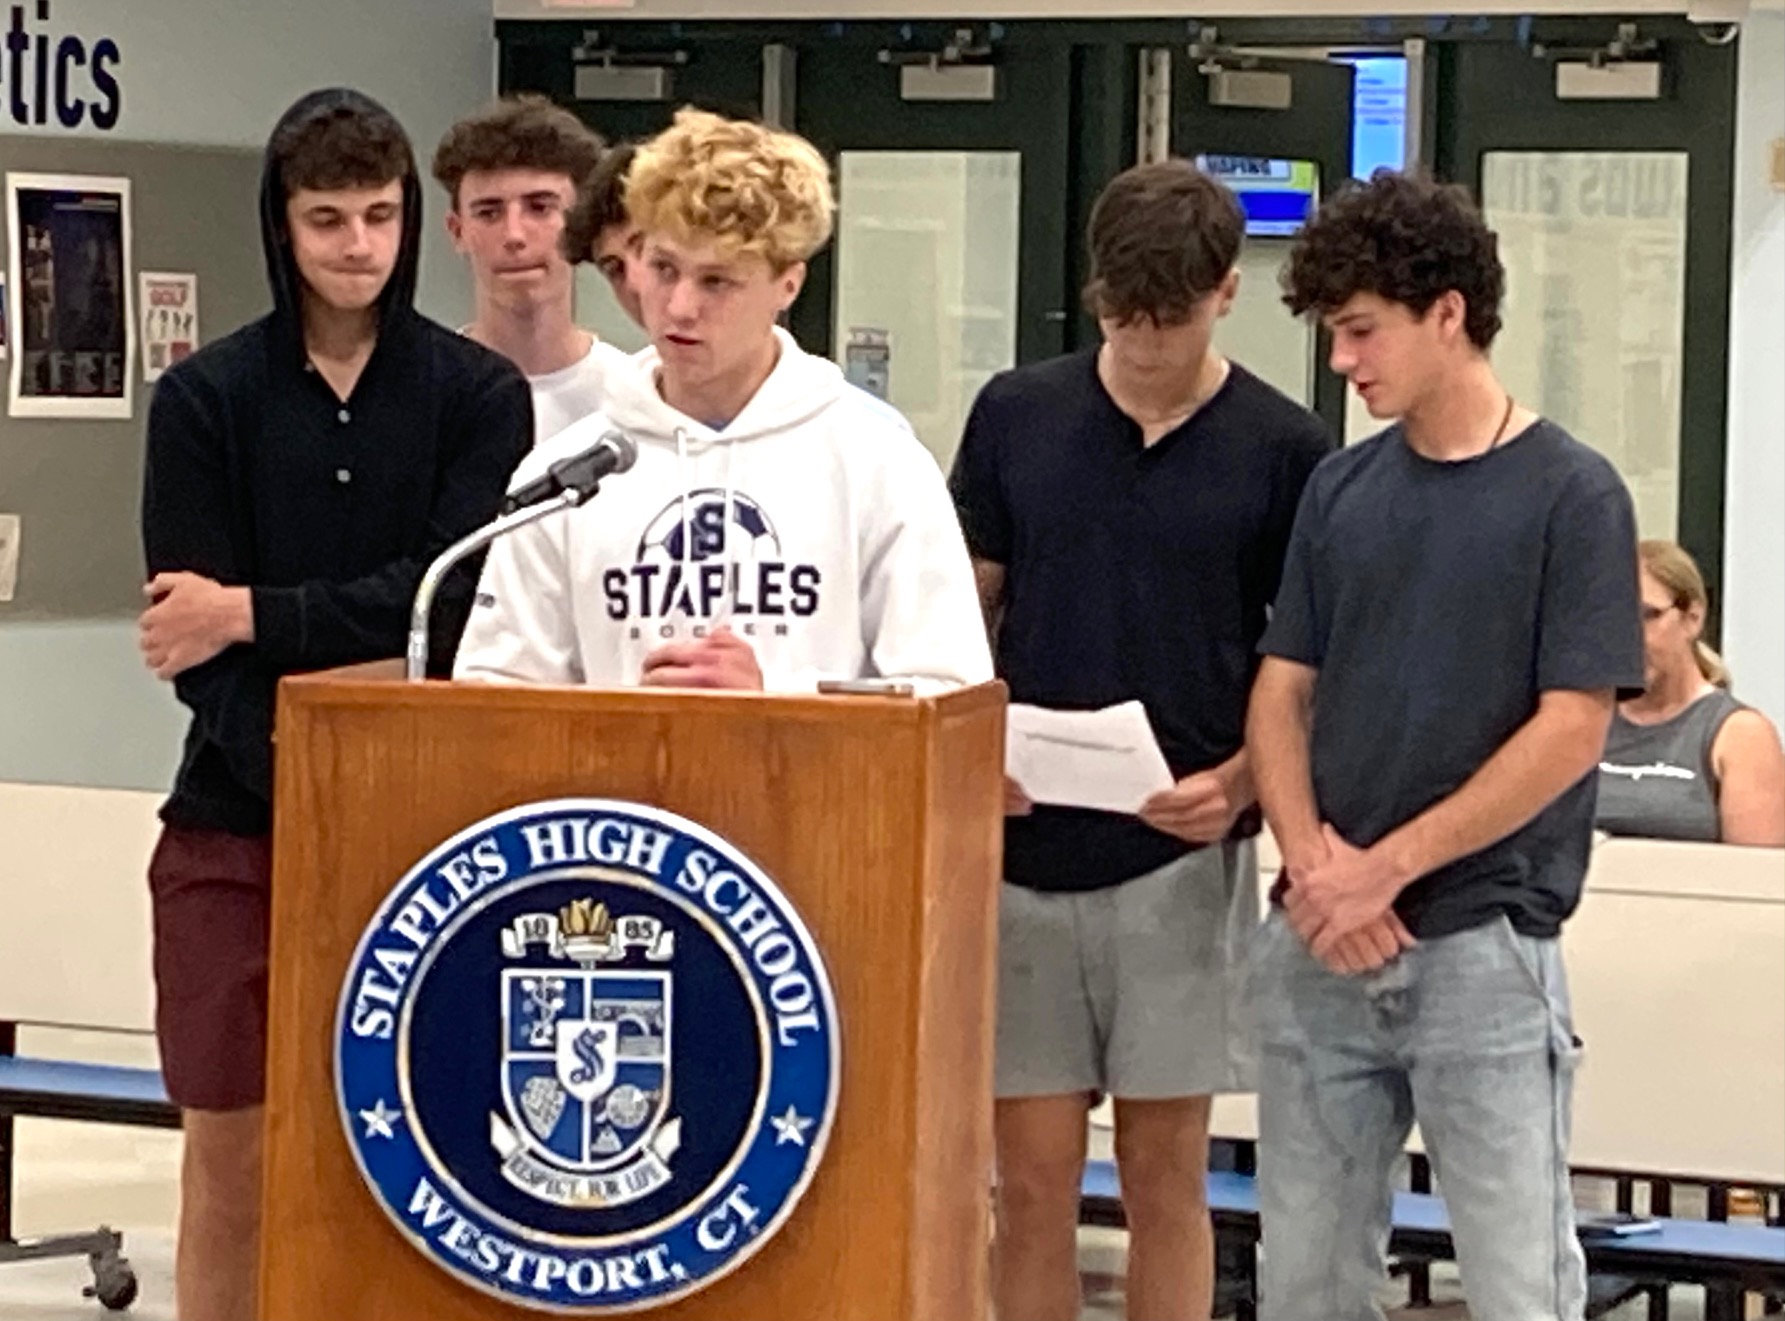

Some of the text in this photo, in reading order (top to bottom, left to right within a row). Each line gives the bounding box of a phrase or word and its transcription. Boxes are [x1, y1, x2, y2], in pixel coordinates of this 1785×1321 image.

[0, 0, 120, 130] tics
[603, 562, 821, 621] STAPLES
[630, 623, 789, 640] SOCER
[352, 818, 821, 1047] STAPLES HIGH SCHOOL
[406, 1176, 761, 1296] WESTPORT, CT
